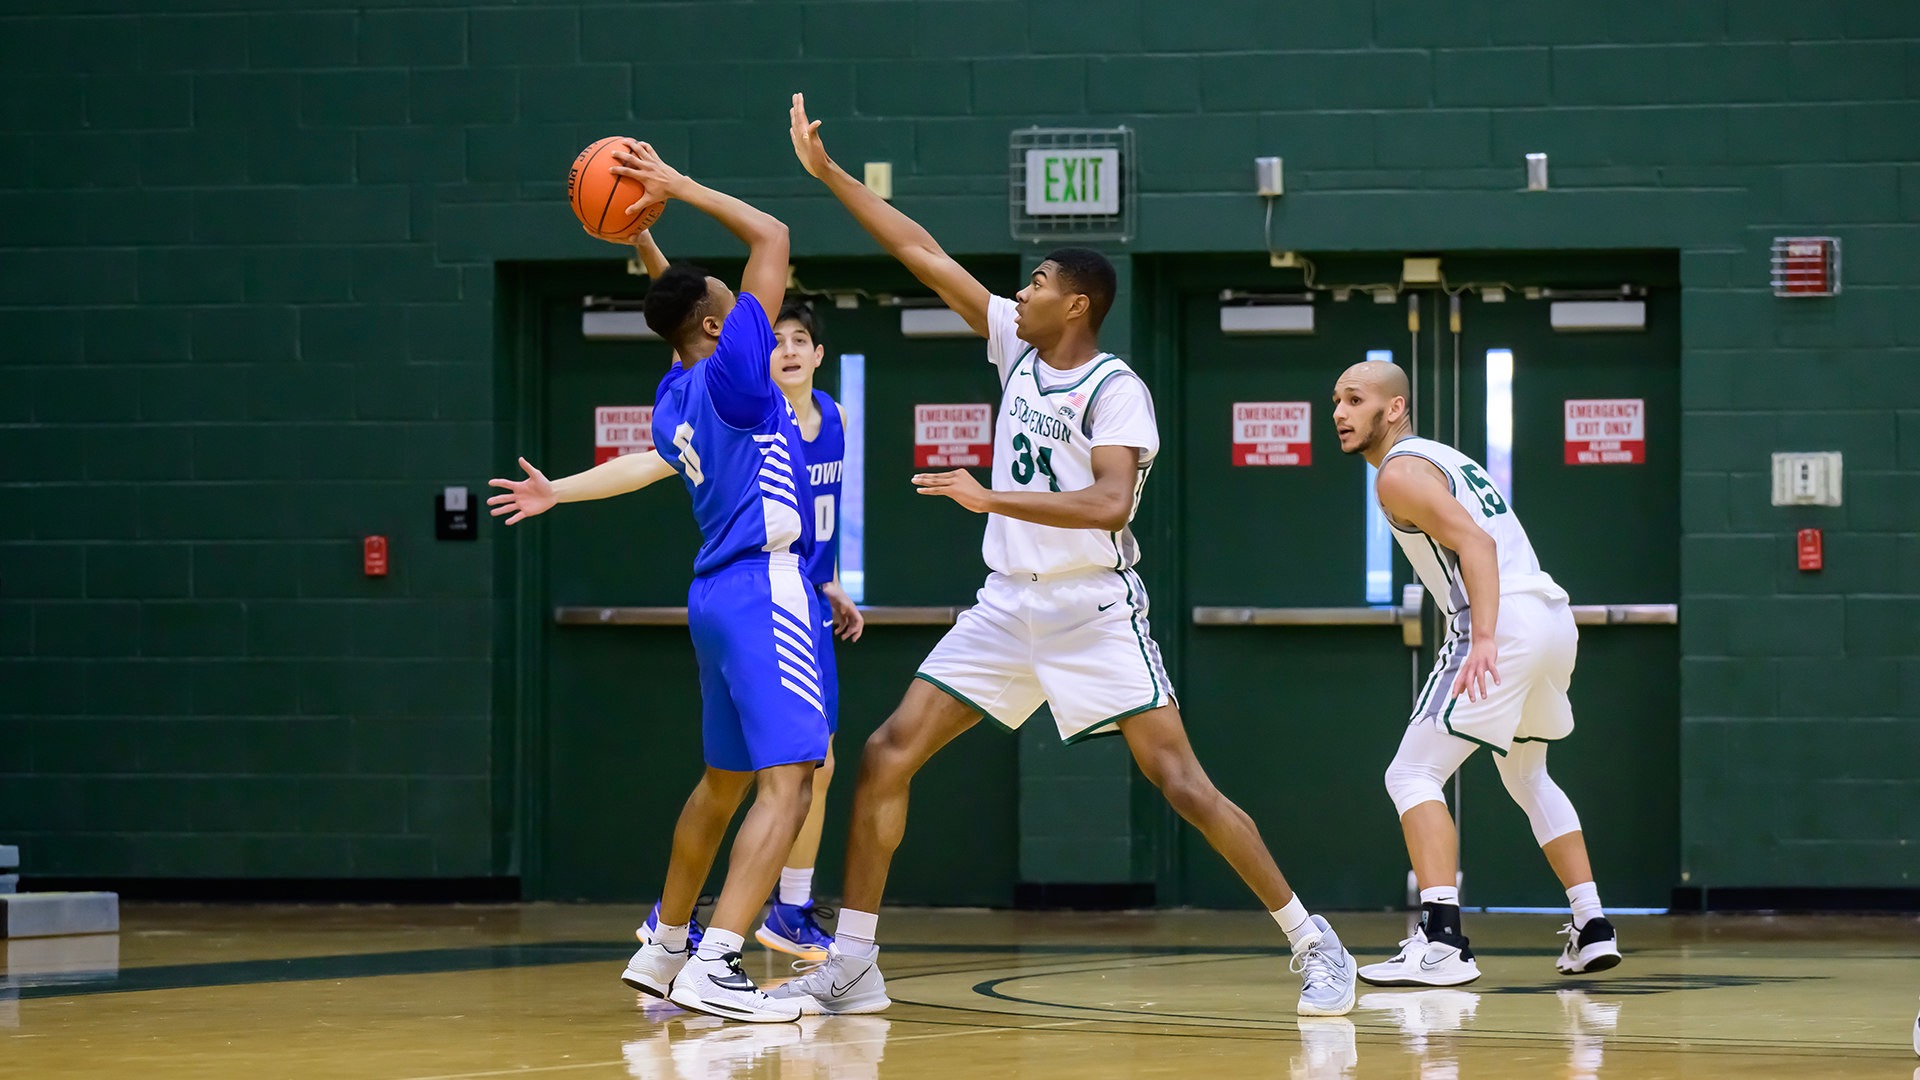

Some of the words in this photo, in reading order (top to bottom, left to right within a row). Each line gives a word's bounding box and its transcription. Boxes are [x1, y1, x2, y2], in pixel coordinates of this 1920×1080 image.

[1045, 157, 1102, 202] EXIT
[600, 411, 652, 424] EMERGEN
[920, 409, 986, 422] EMERGENCY
[1237, 407, 1304, 421] EMERGENCY
[1569, 404, 1638, 418] EMERGENCY
[1010, 396, 1072, 443] STENSON
[606, 427, 628, 442] EXIT
[925, 425, 948, 440] EXIT
[953, 425, 979, 440] ONLY
[1244, 423, 1267, 439] EXIT
[1271, 423, 1298, 438] ONLY
[1576, 421, 1600, 436] EXIT
[1604, 421, 1632, 436] ONLY
[1011, 433, 1061, 492] 34
[806, 460, 843, 486] OWN
[1460, 464, 1507, 518] 15
